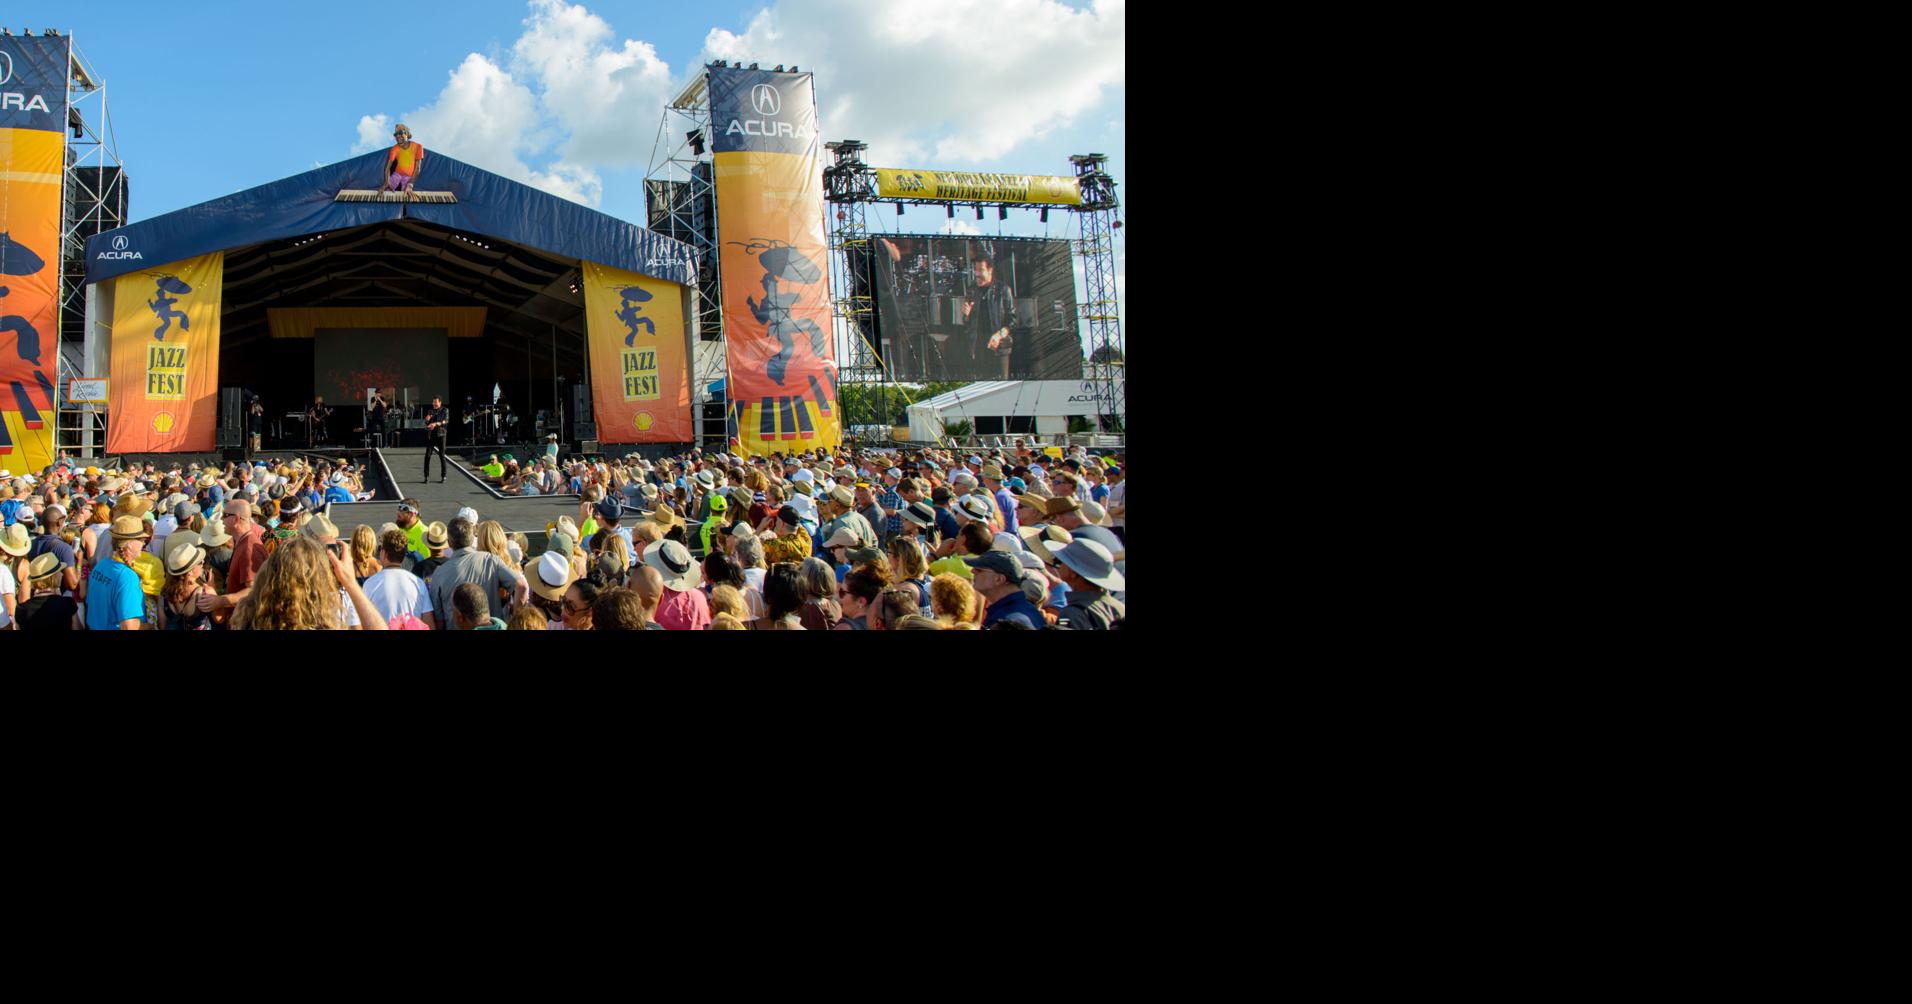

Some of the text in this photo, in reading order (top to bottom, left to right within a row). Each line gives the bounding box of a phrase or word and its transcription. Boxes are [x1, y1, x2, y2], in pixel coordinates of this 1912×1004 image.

[0, 92, 50, 113] RA
[725, 119, 809, 138] ACURA
[935, 185, 983, 200] HERITAGE
[97, 251, 144, 260] ACURA
[645, 258, 686, 267] ACURA
[148, 347, 185, 370] JAZZ
[623, 351, 656, 375] JAZZ
[148, 373, 185, 394] FEST
[625, 375, 657, 396] FEST
[1068, 394, 1113, 402] ACURA
[91, 569, 112, 586] STAFF
